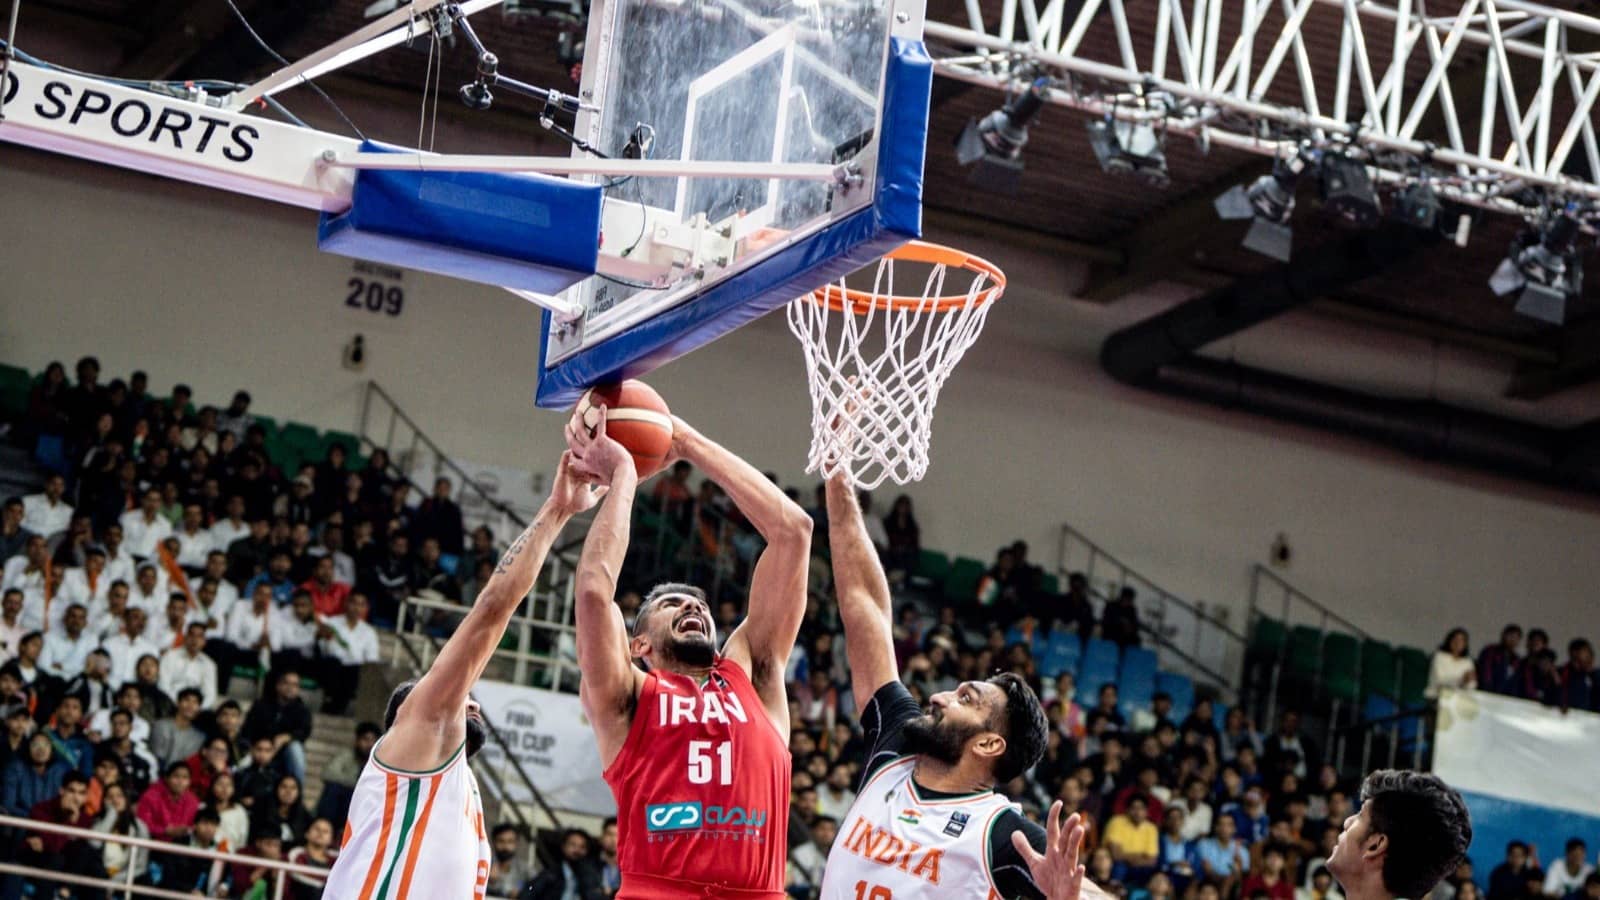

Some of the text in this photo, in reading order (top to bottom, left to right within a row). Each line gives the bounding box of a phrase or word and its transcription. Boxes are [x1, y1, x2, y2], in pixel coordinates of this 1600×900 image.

[34, 81, 260, 162] SPORTS
[345, 277, 404, 316] 209
[659, 691, 748, 728] IRAN
[522, 731, 556, 752] CUP
[688, 740, 732, 785] 51
[843, 816, 945, 885] INDIA
